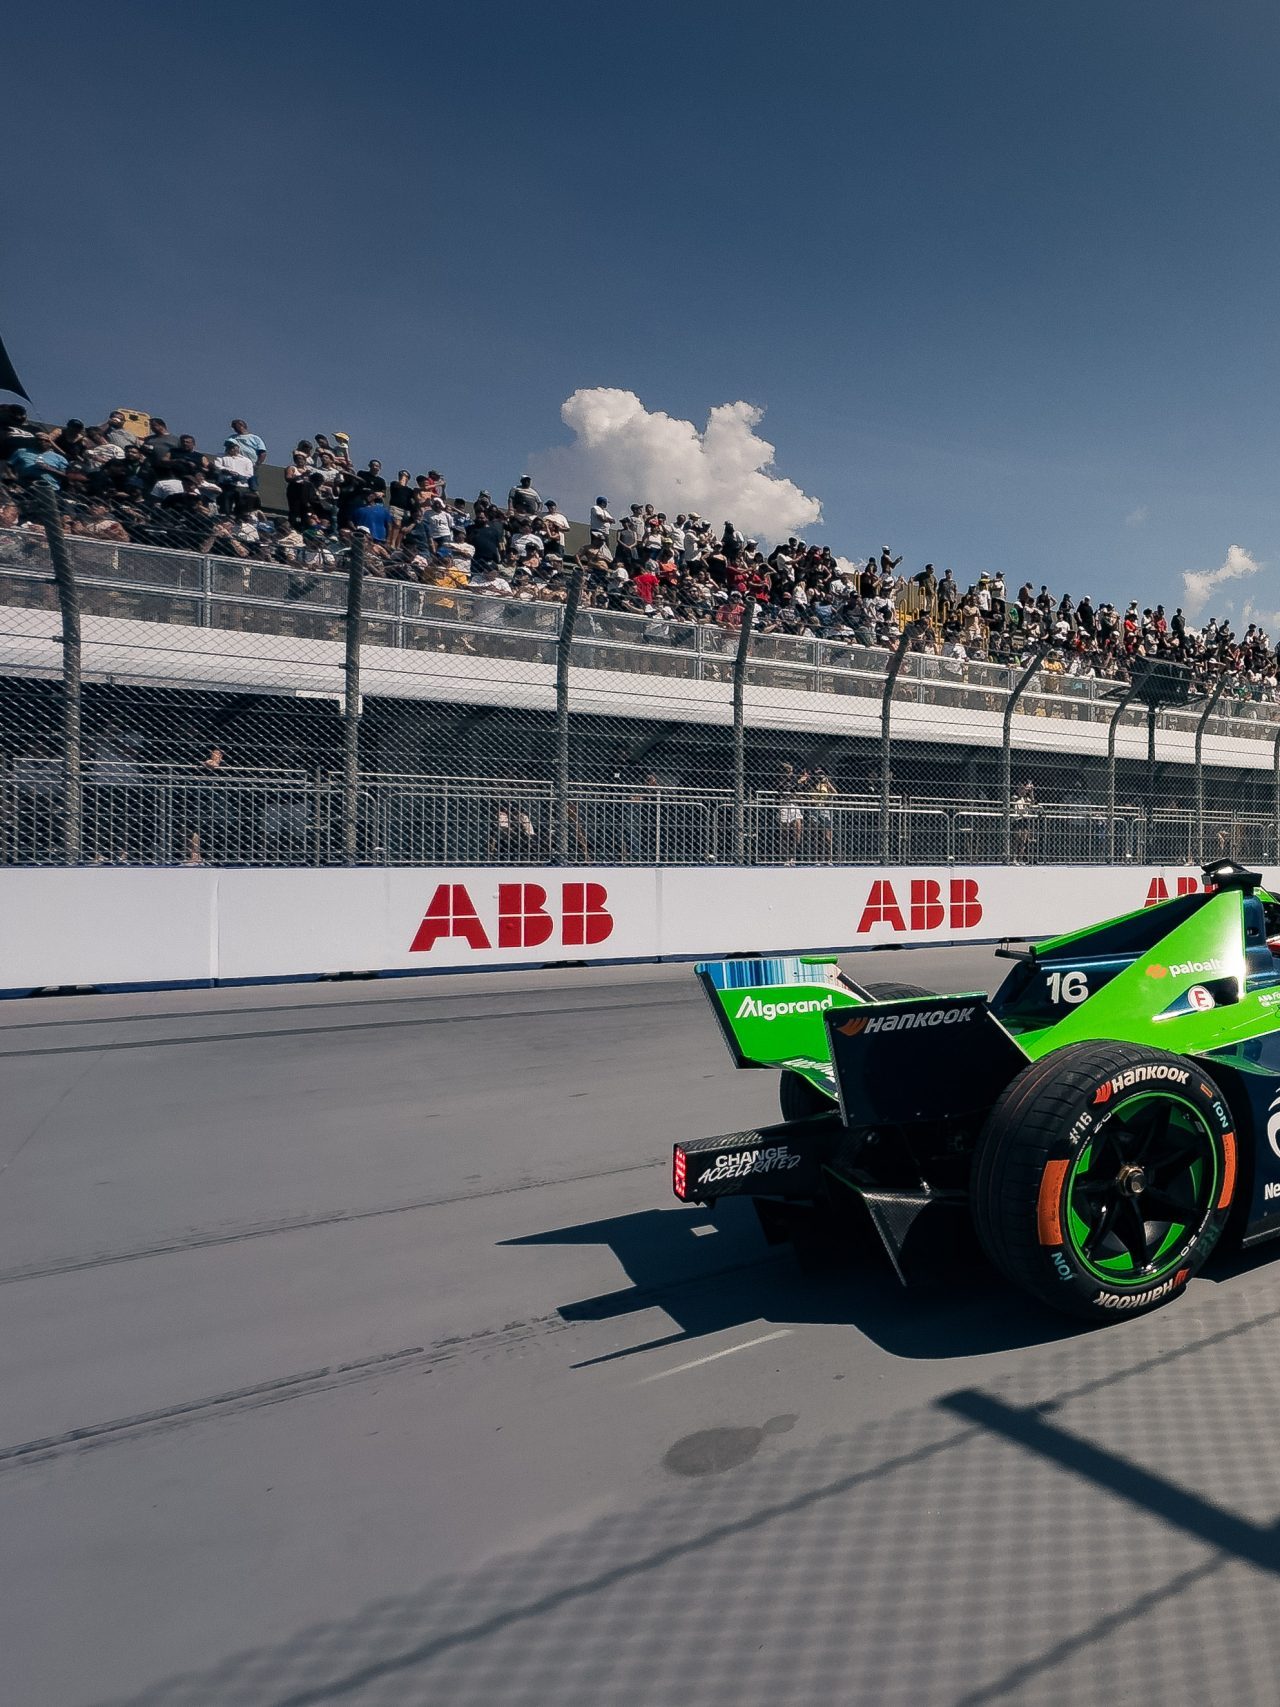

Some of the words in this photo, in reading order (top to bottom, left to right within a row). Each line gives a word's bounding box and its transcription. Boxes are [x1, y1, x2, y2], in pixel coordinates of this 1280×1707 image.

[408, 882, 614, 953] ABB
[856, 879, 983, 933] ABB
[1046, 971, 1089, 1004] 16
[1194, 989, 1210, 1009] E
[735, 995, 833, 1021] Algorand
[1069, 1111, 1093, 1145] #16
[697, 1154, 801, 1184] ACCELERATED
[715, 1146, 788, 1168] CHANGE
